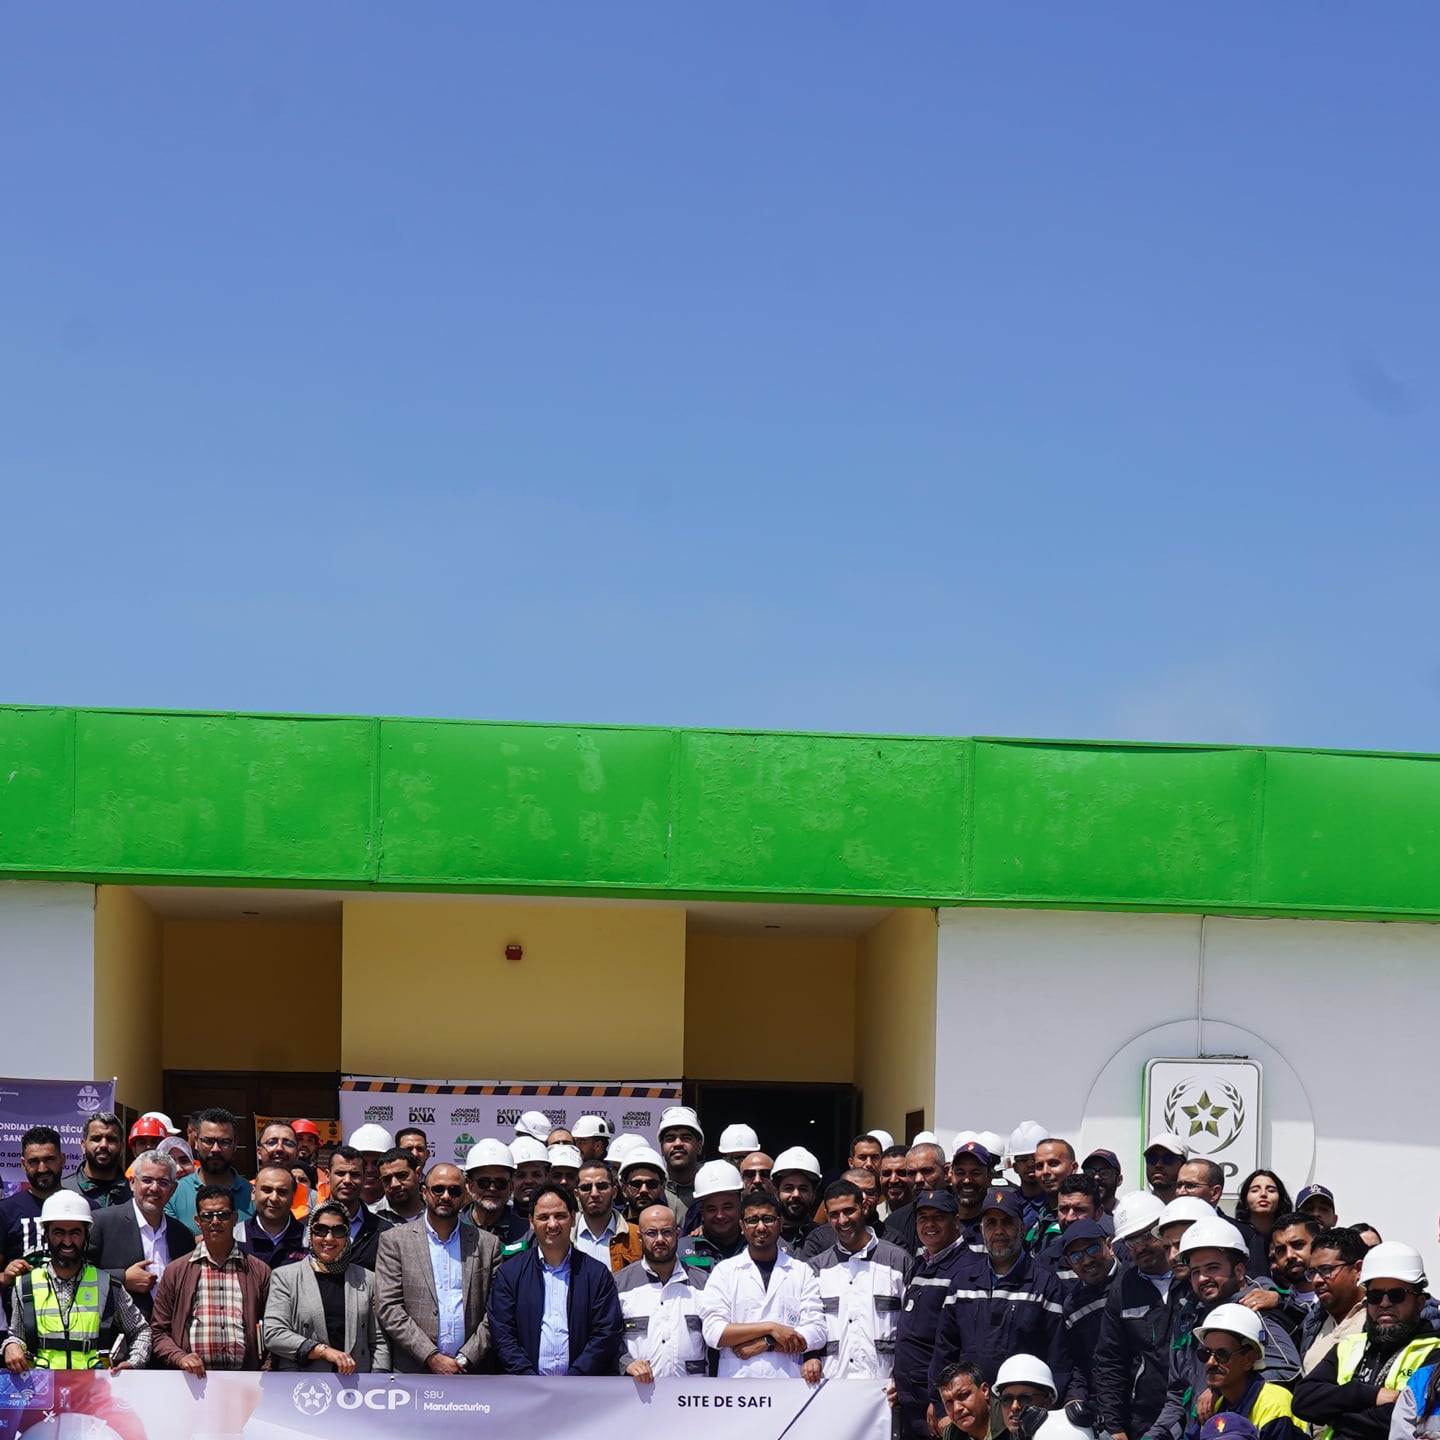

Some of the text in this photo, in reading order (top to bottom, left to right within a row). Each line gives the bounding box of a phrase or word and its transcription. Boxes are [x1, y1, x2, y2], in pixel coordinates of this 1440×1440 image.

[408, 1113, 436, 1123] DNA
[336, 1388, 411, 1410] OCP
[423, 1390, 444, 1399] SBU
[677, 1395, 772, 1408] SITE DE SAFI
[423, 1402, 491, 1413] Manufacturing
